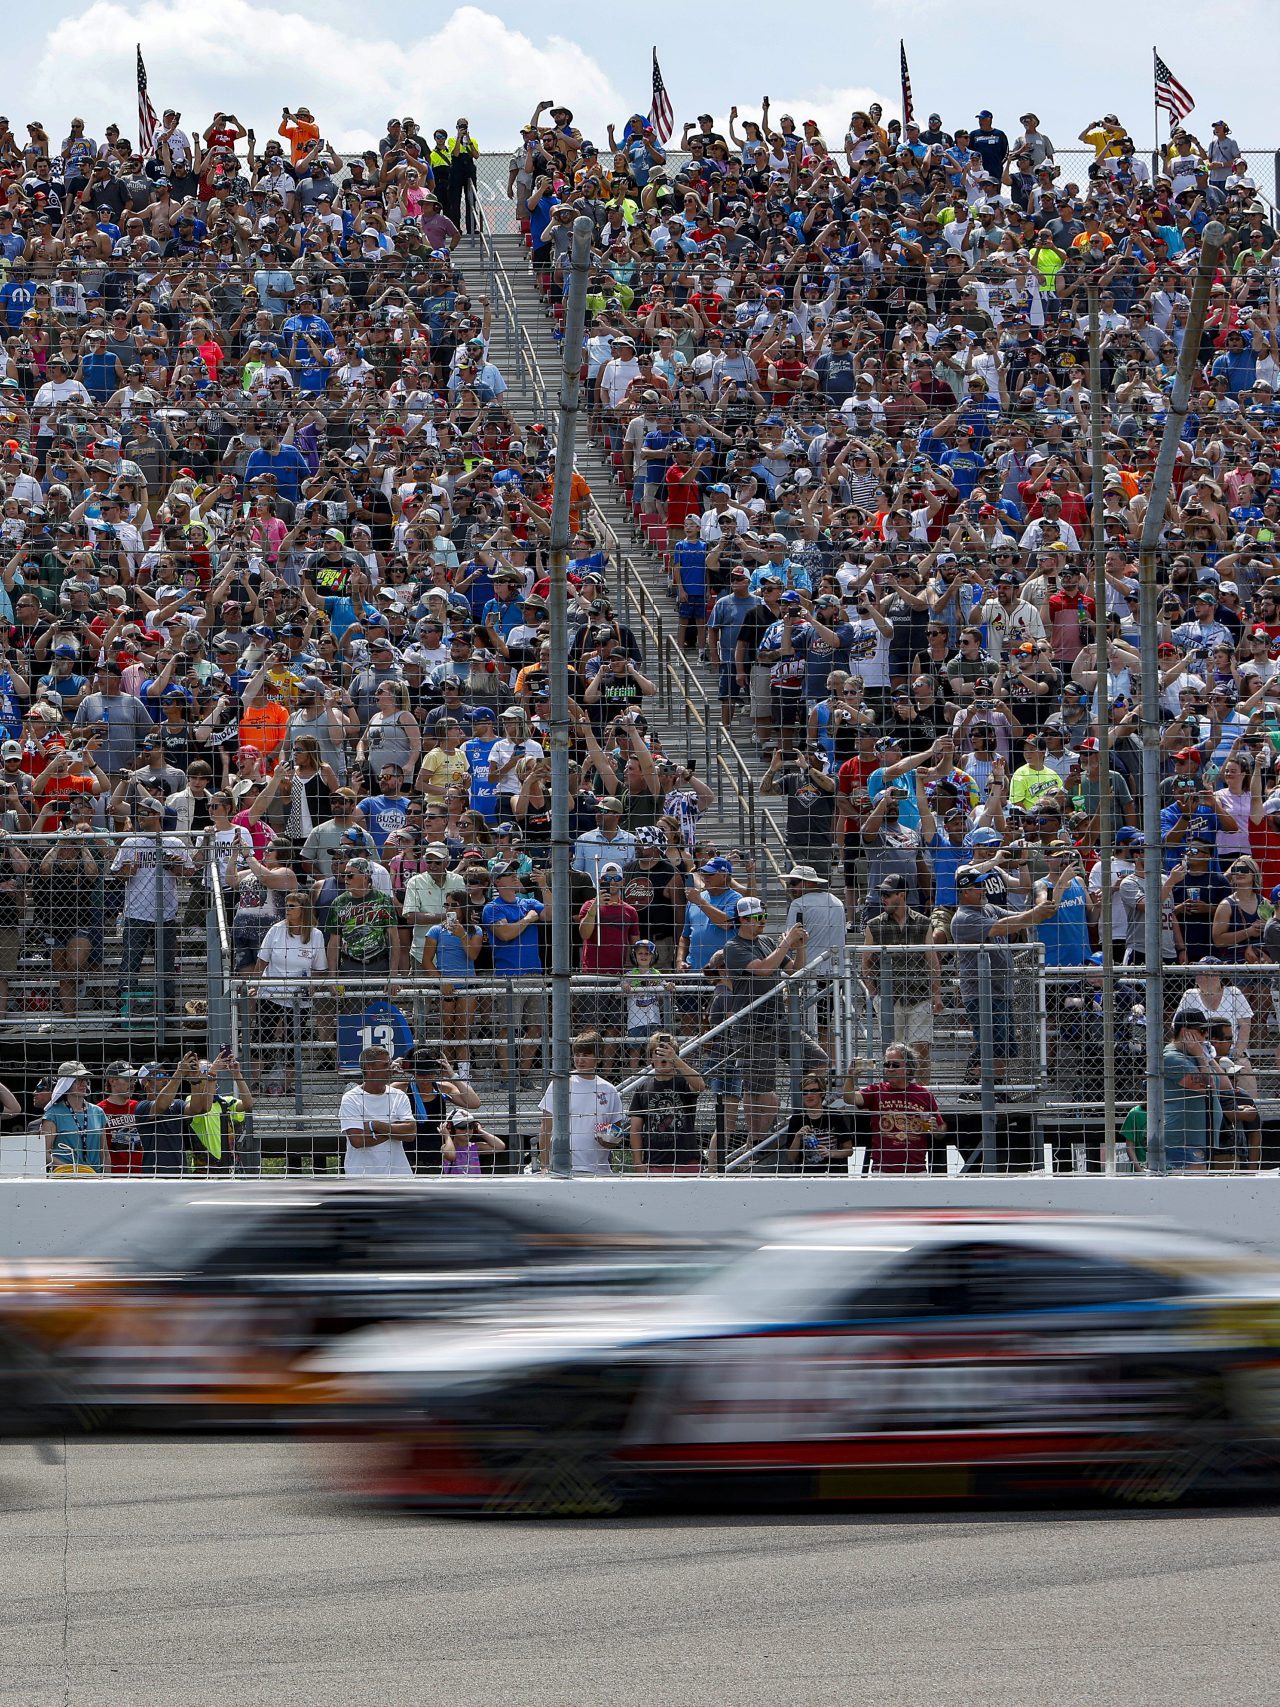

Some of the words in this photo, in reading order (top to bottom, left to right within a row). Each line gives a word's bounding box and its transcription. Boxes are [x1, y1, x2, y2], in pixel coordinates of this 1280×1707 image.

[886, 286, 906, 309] 4
[317, 569, 341, 579] BYRON
[322, 578, 335, 586] 24
[377, 814, 406, 826] BUSCH
[626, 883, 654, 899] Camaro
[984, 876, 1007, 895] USA
[357, 1026, 394, 1051] 13
[879, 1099, 926, 1111] AMERICAN
